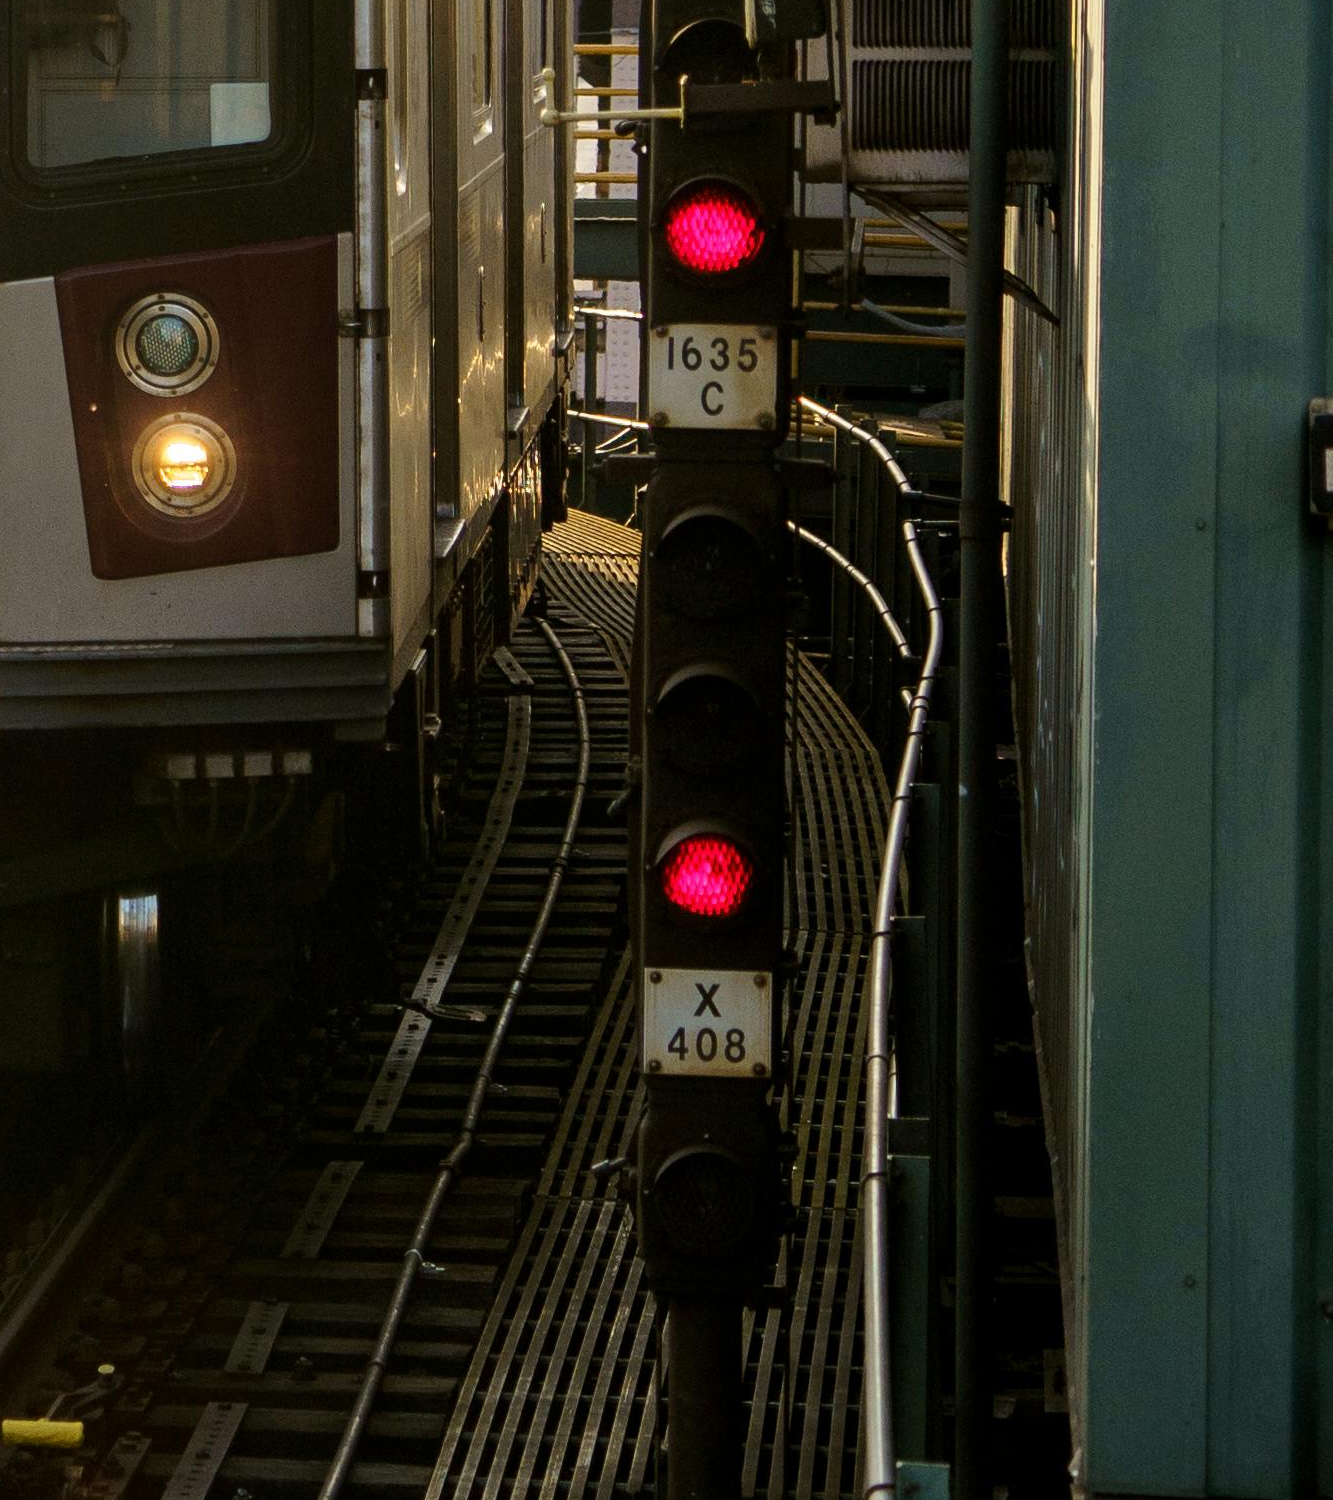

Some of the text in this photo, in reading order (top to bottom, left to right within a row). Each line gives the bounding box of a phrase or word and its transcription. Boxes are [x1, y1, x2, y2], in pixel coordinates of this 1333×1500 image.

[668, 336, 758, 373] 1635
[701, 381, 724, 417] C
[694, 982, 722, 1018] X
[667, 1026, 746, 1063] 408
